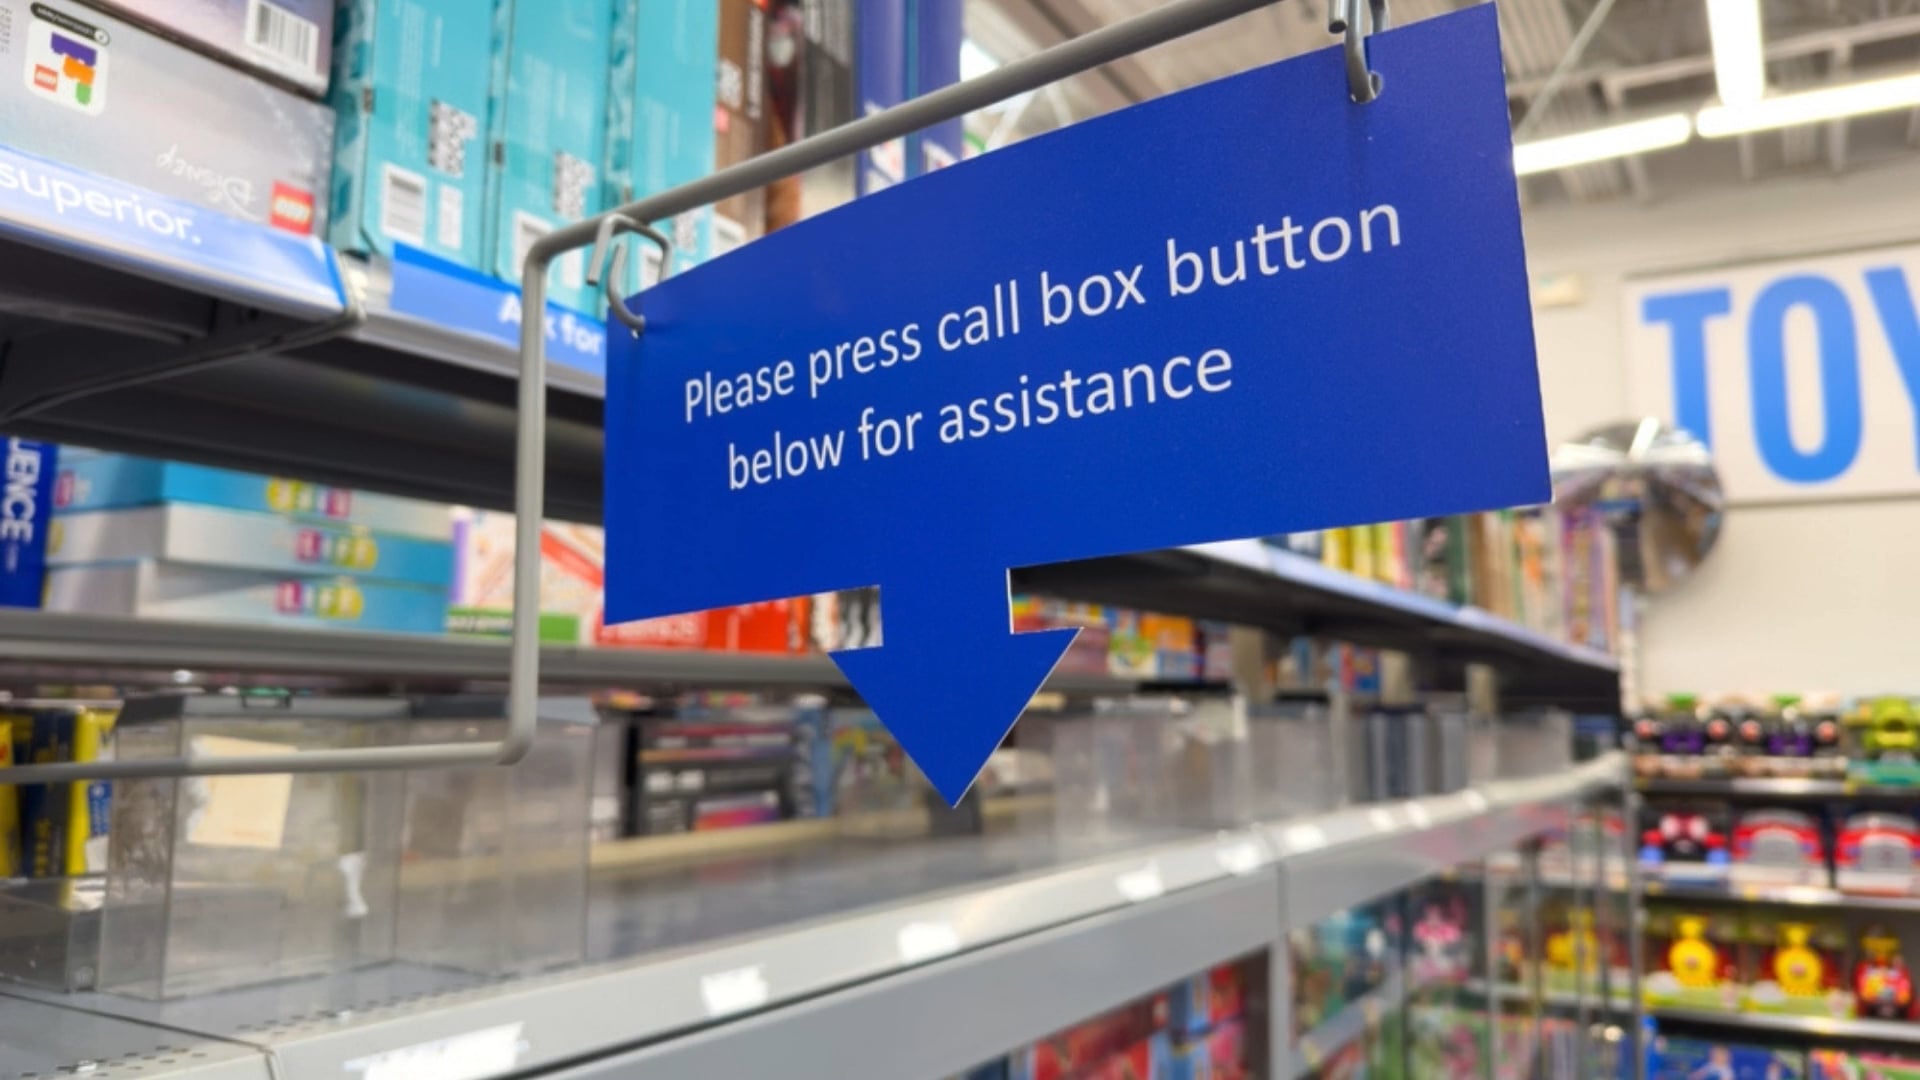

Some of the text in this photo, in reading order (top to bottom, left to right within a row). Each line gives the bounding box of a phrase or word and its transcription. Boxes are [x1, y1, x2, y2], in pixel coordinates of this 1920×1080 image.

[686, 204, 1401, 423] Please press call box button
[729, 348, 1232, 490] below for assistance
